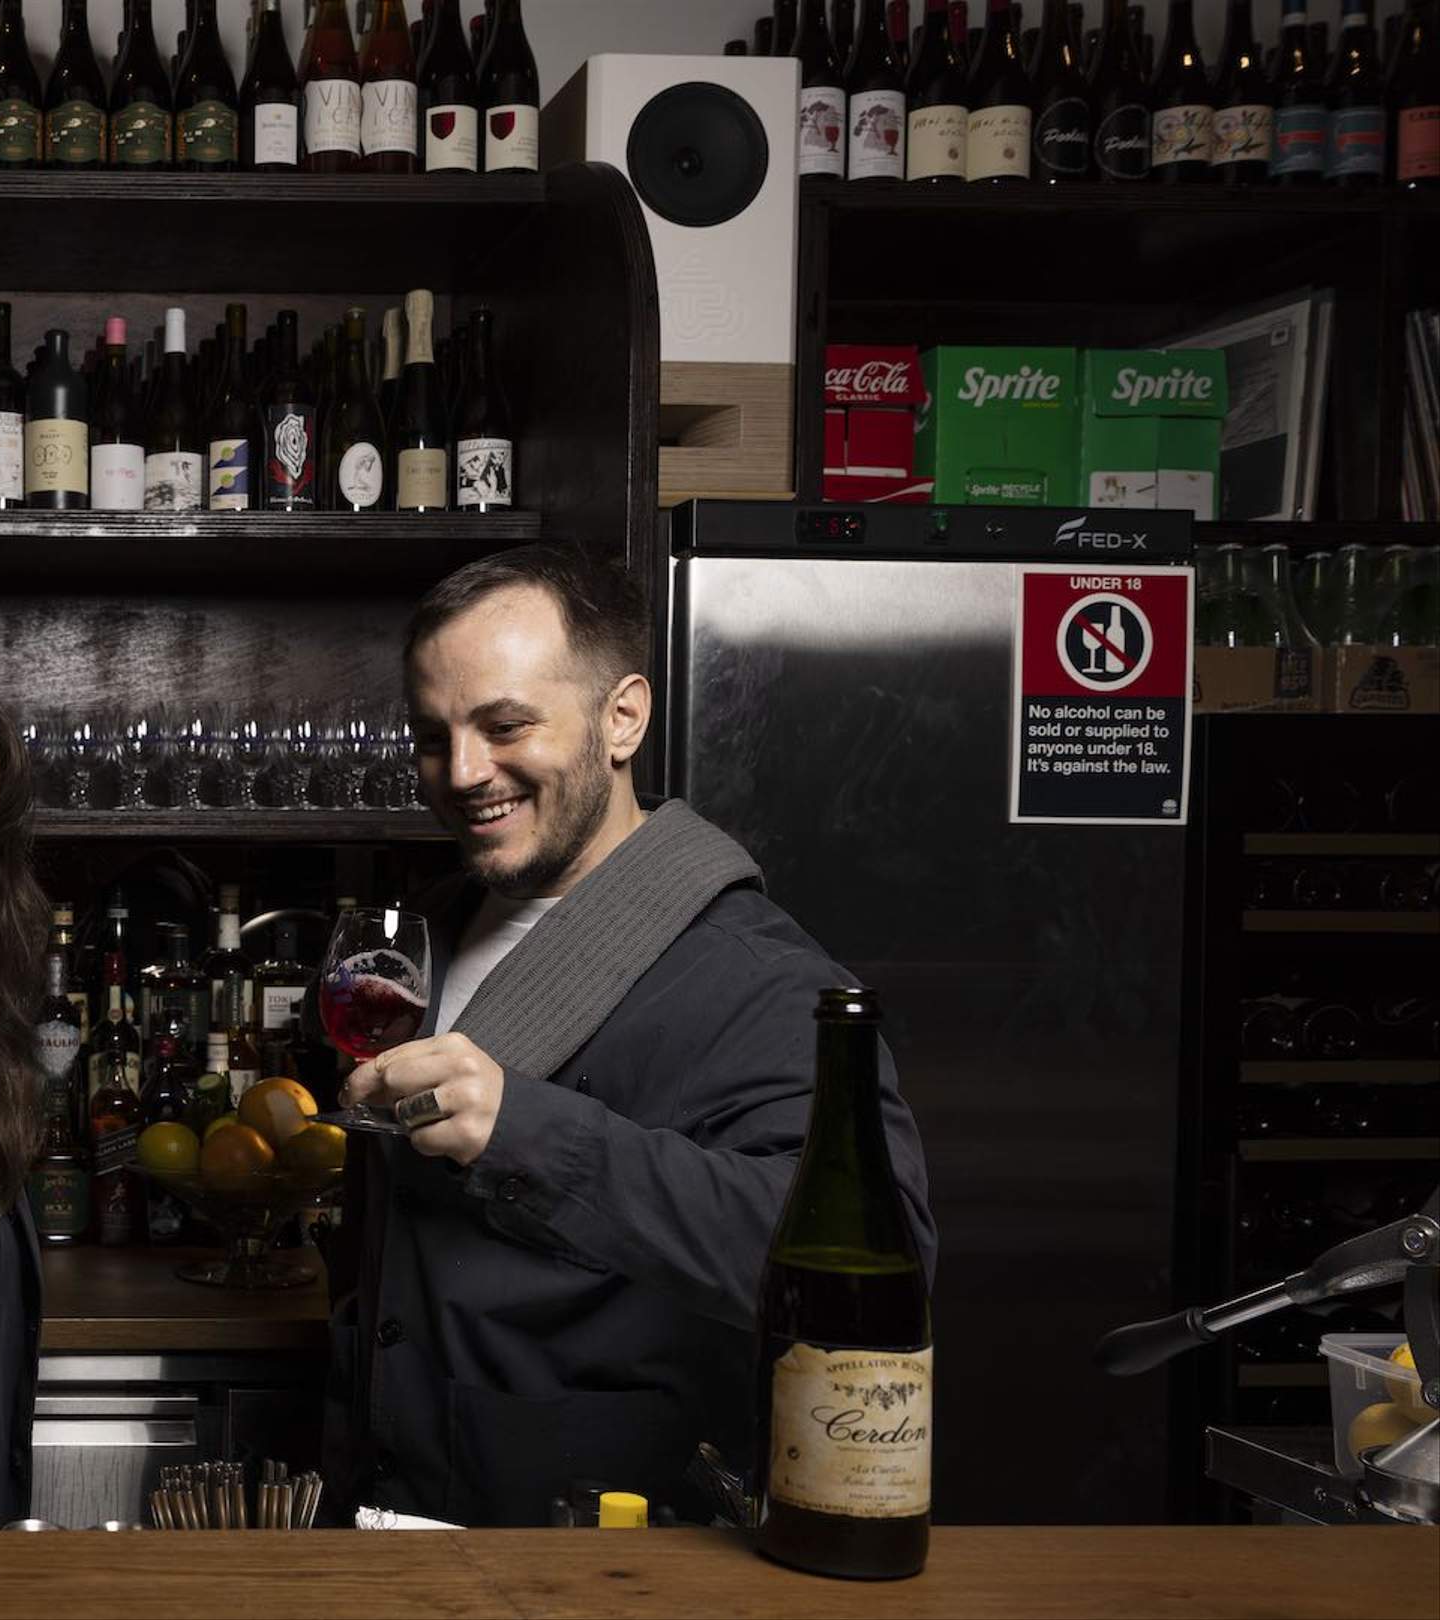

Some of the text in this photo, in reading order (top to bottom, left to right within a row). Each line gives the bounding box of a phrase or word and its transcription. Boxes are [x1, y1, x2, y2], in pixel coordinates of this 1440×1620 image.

[824, 361, 912, 394] ca-Cola
[956, 365, 1061, 407] Sprite
[1111, 367, 1214, 407] Sprite
[1078, 532, 1148, 550] FED-X
[1069, 576, 1142, 591] UNDER 18
[1028, 704, 1166, 722] No alcohol can be
[1028, 723, 1170, 741] sold or supplied to
[1027, 741, 1158, 757] anyone under 18.
[1027, 758, 1172, 776] It's against the law.
[810, 1405, 928, 1444] Cerdon
